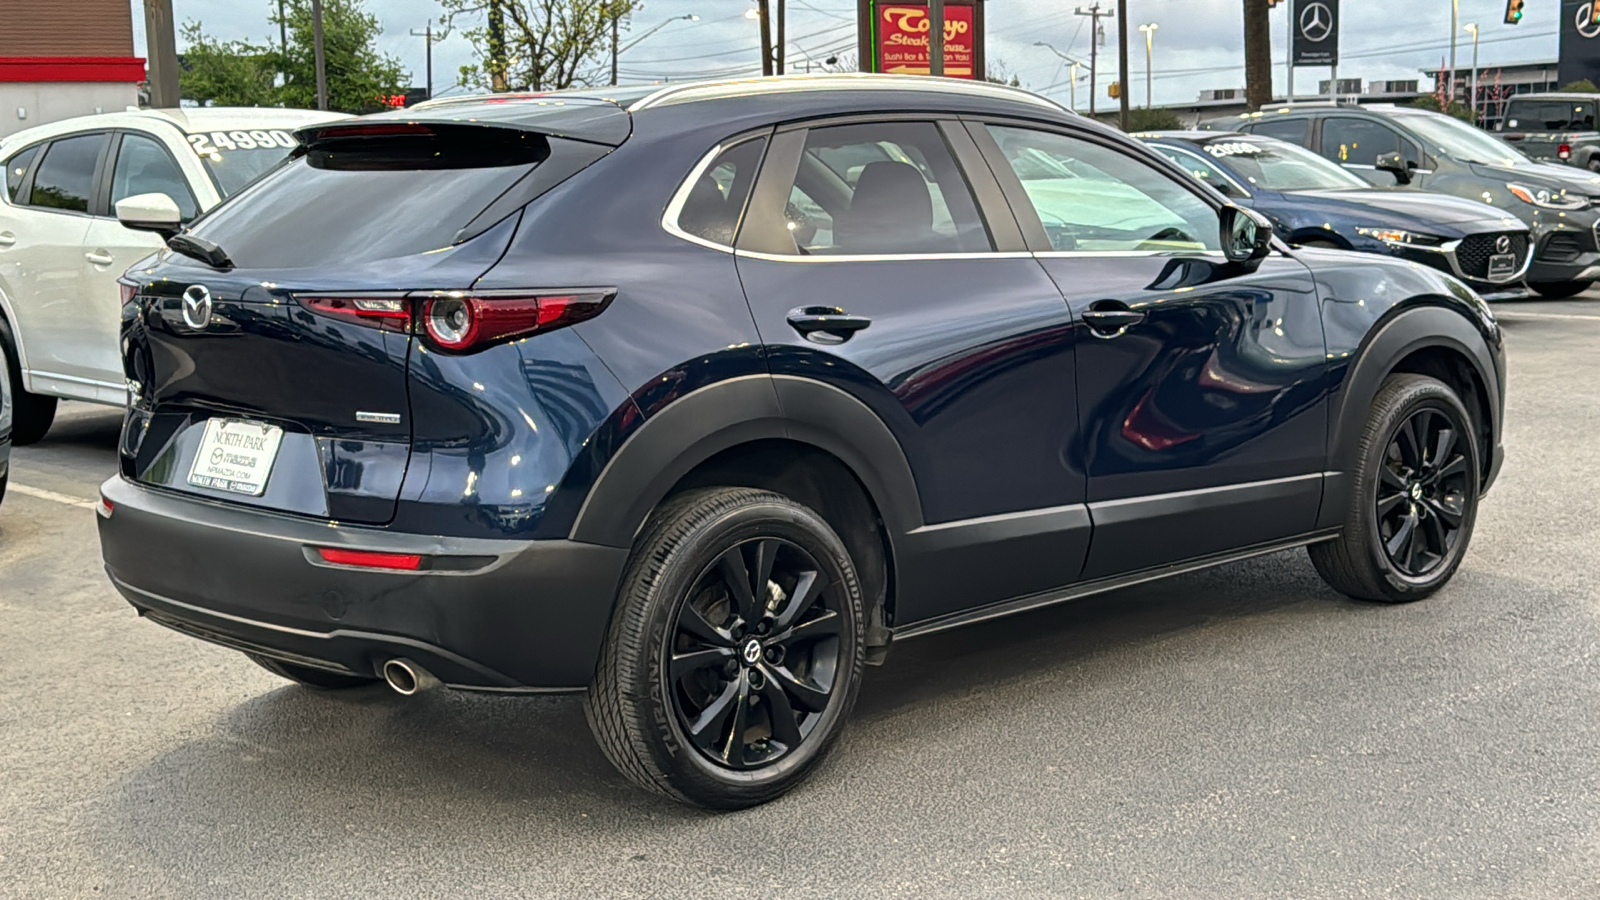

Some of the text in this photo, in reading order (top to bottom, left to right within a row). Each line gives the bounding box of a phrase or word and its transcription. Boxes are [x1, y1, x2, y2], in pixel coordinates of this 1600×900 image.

[884, 8, 968, 40] Toyo
[884, 33, 930, 46] Steak
[187, 130, 297, 154] 24990
[213, 430, 268, 451] NORTH PARK
[223, 453, 257, 468] mazda
[207, 466, 251, 479] NPMAZDA.COM
[191, 475, 212, 485] NORTH
[210, 477, 229, 489] PARK
[649, 625, 680, 758] TURANZA
